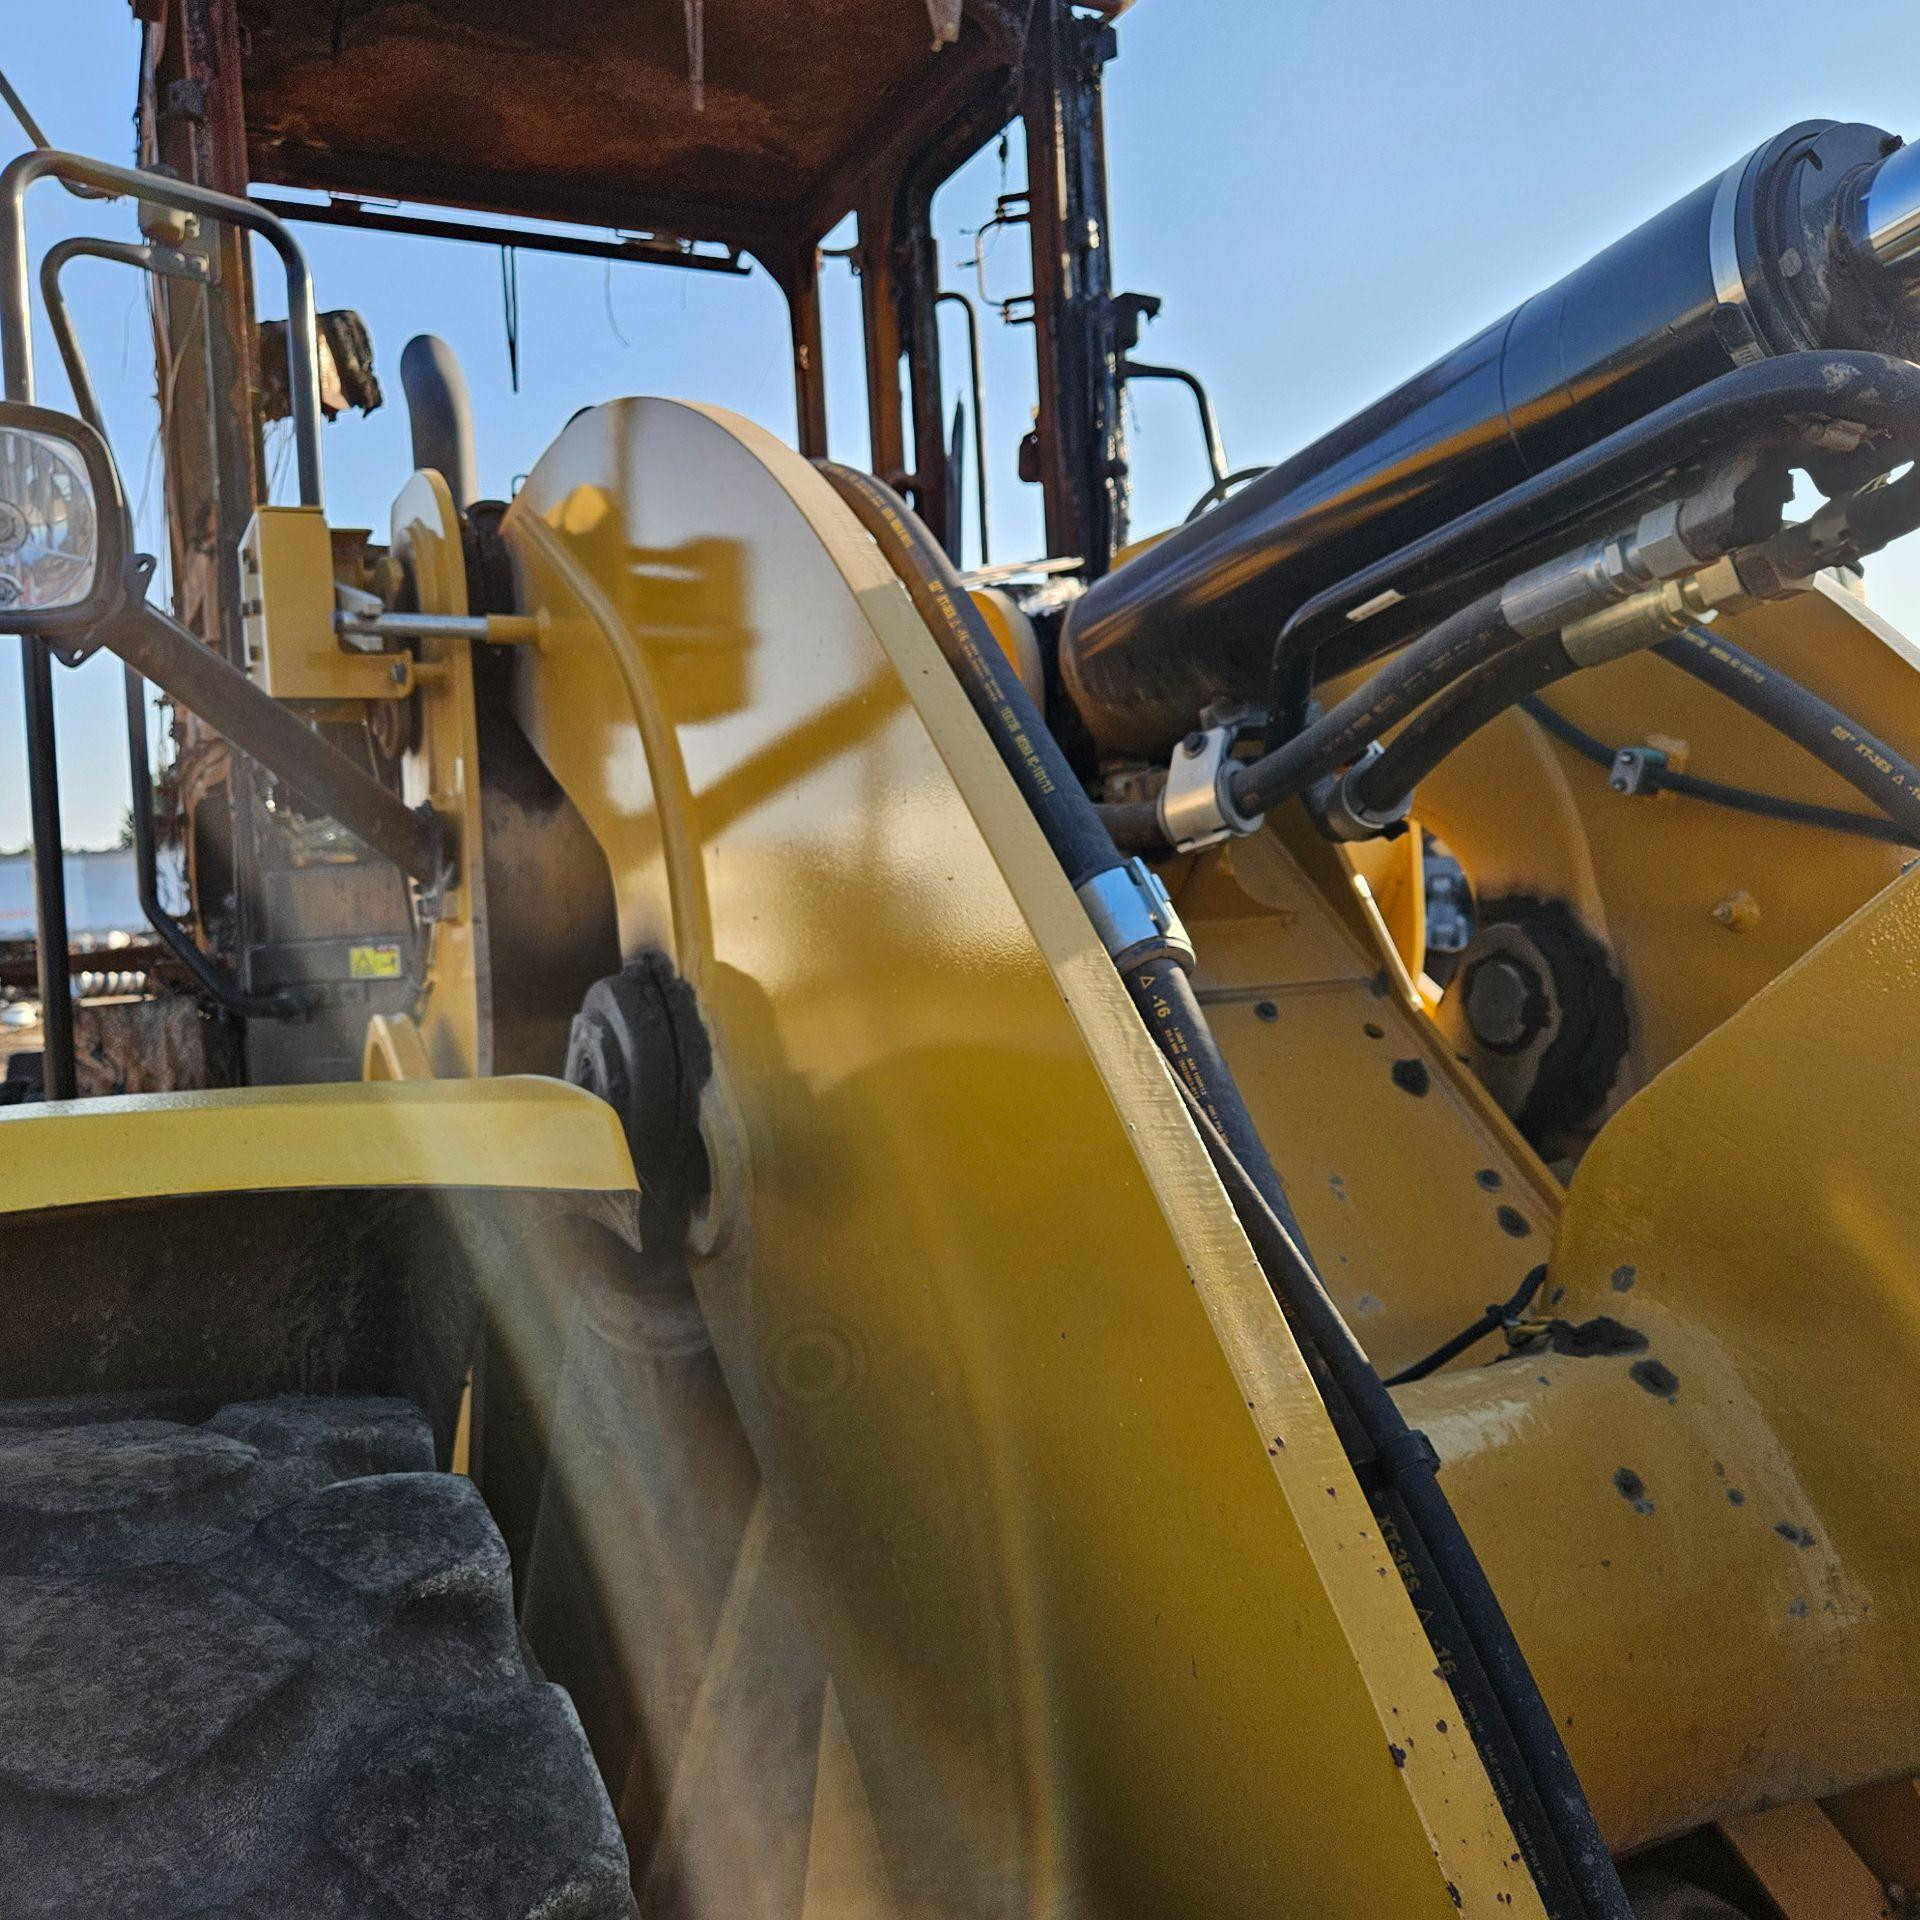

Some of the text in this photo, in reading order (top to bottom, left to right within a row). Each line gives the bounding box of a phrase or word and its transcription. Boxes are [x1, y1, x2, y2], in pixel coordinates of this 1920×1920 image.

[1153, 995, 1171, 1019] -16
[1377, 1513, 1456, 1675] XT-3ES -16
